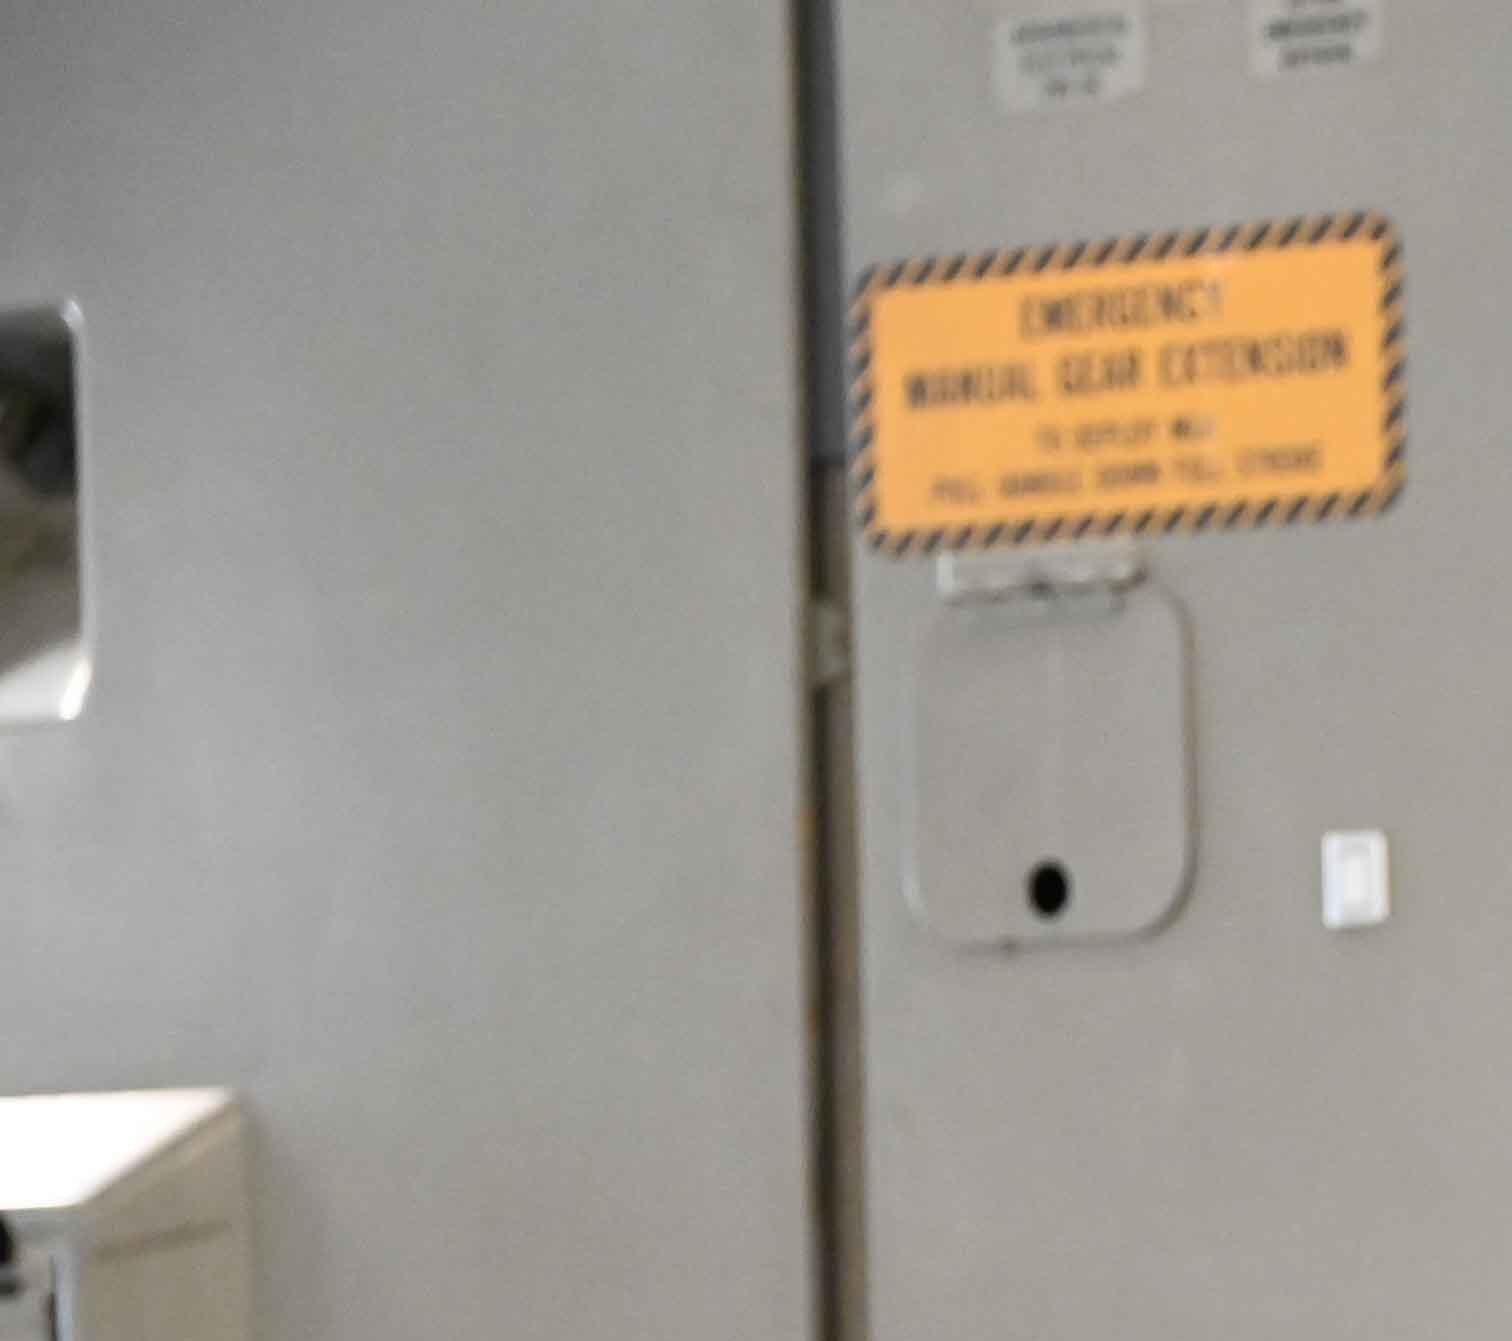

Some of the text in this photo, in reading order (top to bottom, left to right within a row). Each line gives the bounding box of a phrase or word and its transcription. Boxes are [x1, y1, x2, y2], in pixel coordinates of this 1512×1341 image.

[1018, 280, 1223, 339] EMERGENCY
[906, 328, 1350, 409] MANUAL GEAR EXTENSION
